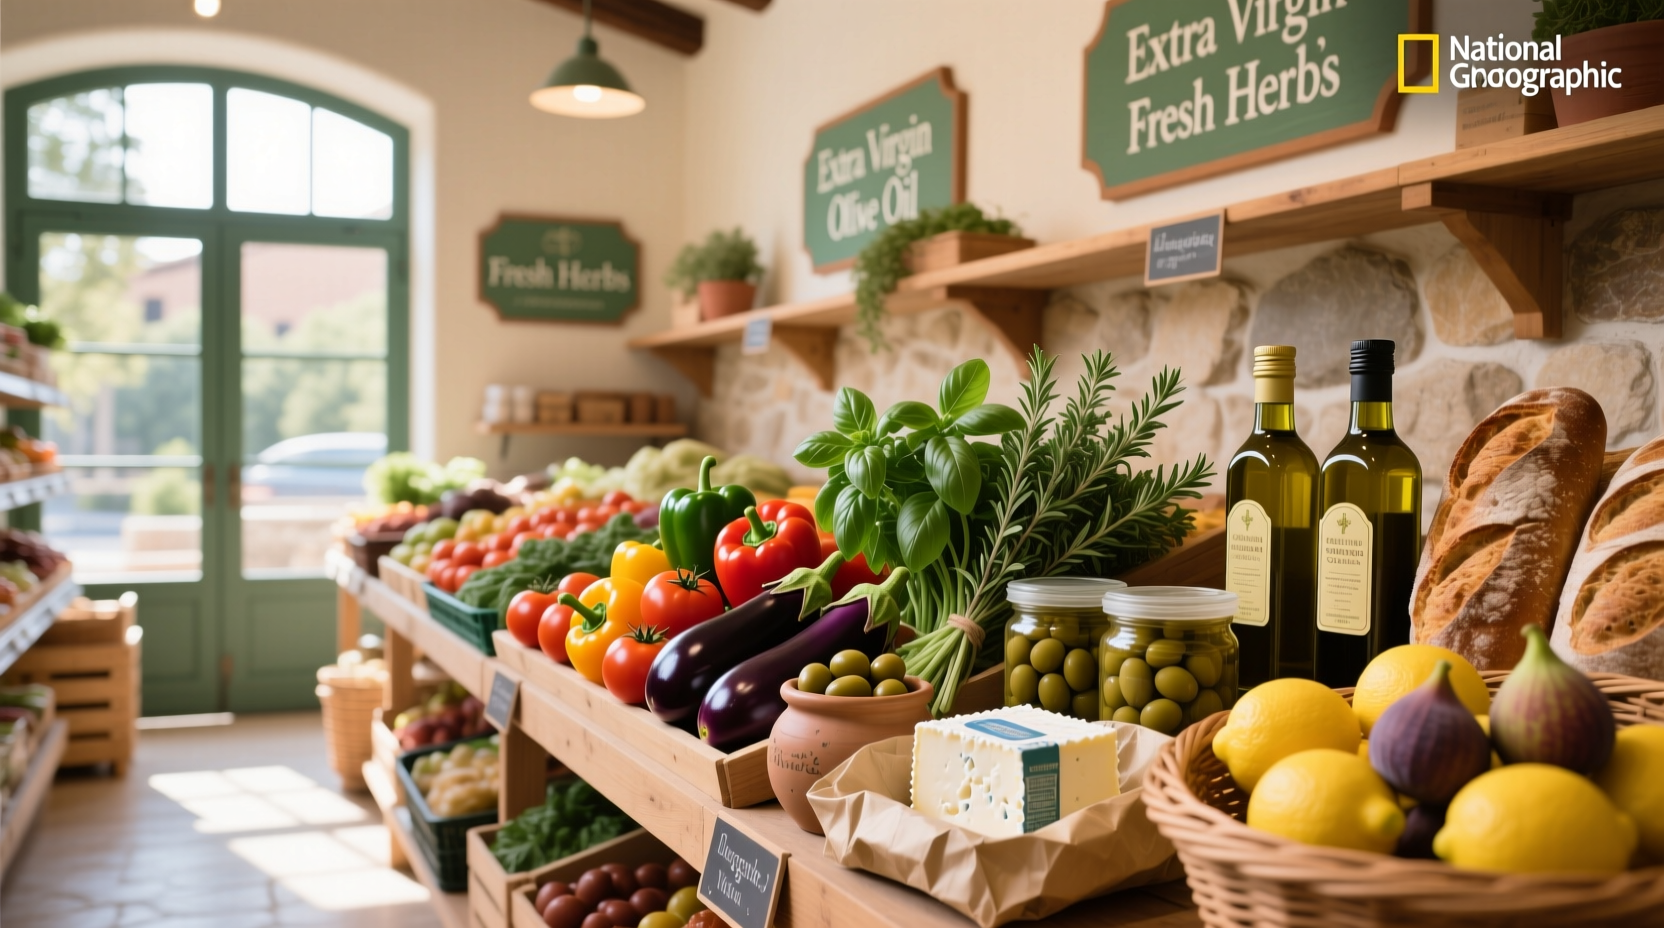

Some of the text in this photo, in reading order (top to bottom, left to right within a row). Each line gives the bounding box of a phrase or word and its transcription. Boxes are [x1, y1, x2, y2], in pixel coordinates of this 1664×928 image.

[1125, 0, 1347, 85] Extra Virg
[816, 113, 933, 194] Extra Virgin
[1126, 77, 1216, 155] Fresh
[826, 168, 919, 242] Olive Oil
[488, 255, 632, 293] Fresh Herbs
